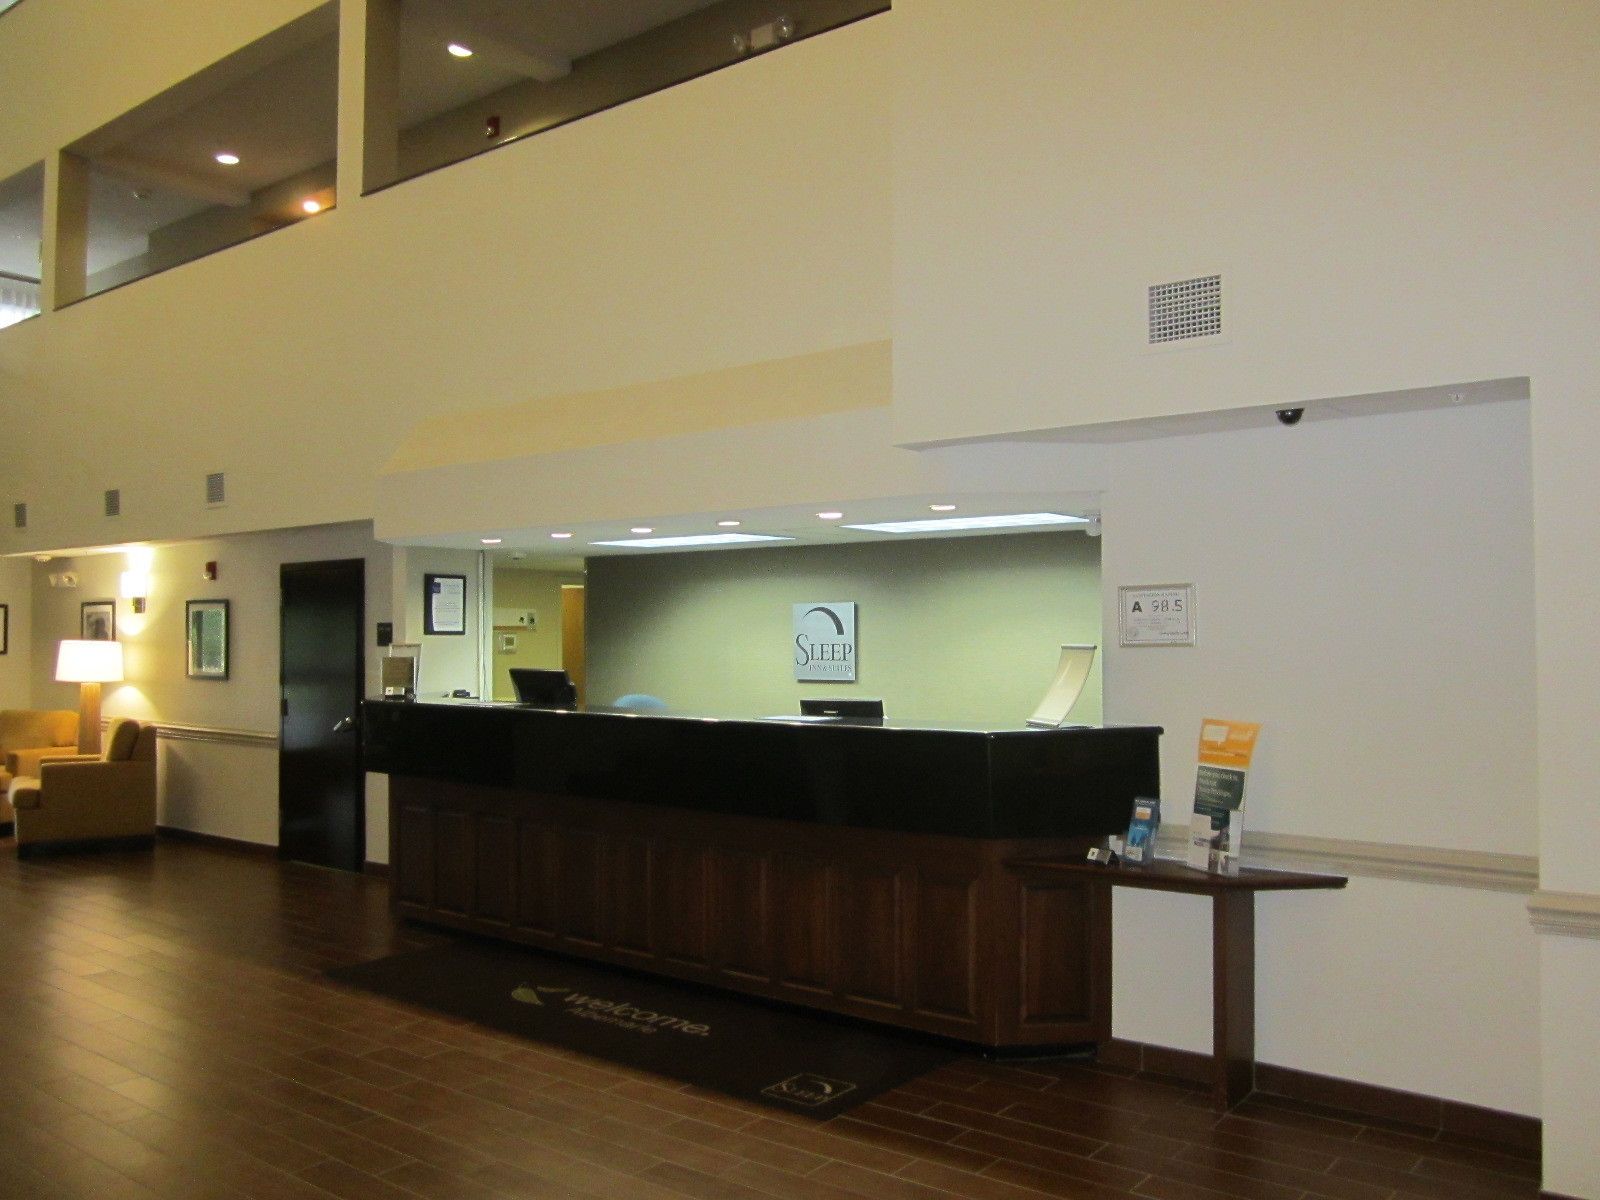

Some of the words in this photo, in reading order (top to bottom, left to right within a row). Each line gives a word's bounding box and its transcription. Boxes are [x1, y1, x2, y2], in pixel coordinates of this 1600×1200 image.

[1131, 600, 1143, 613] A
[1151, 599, 1183, 612] 98.5
[795, 633, 853, 666] SLEEP
